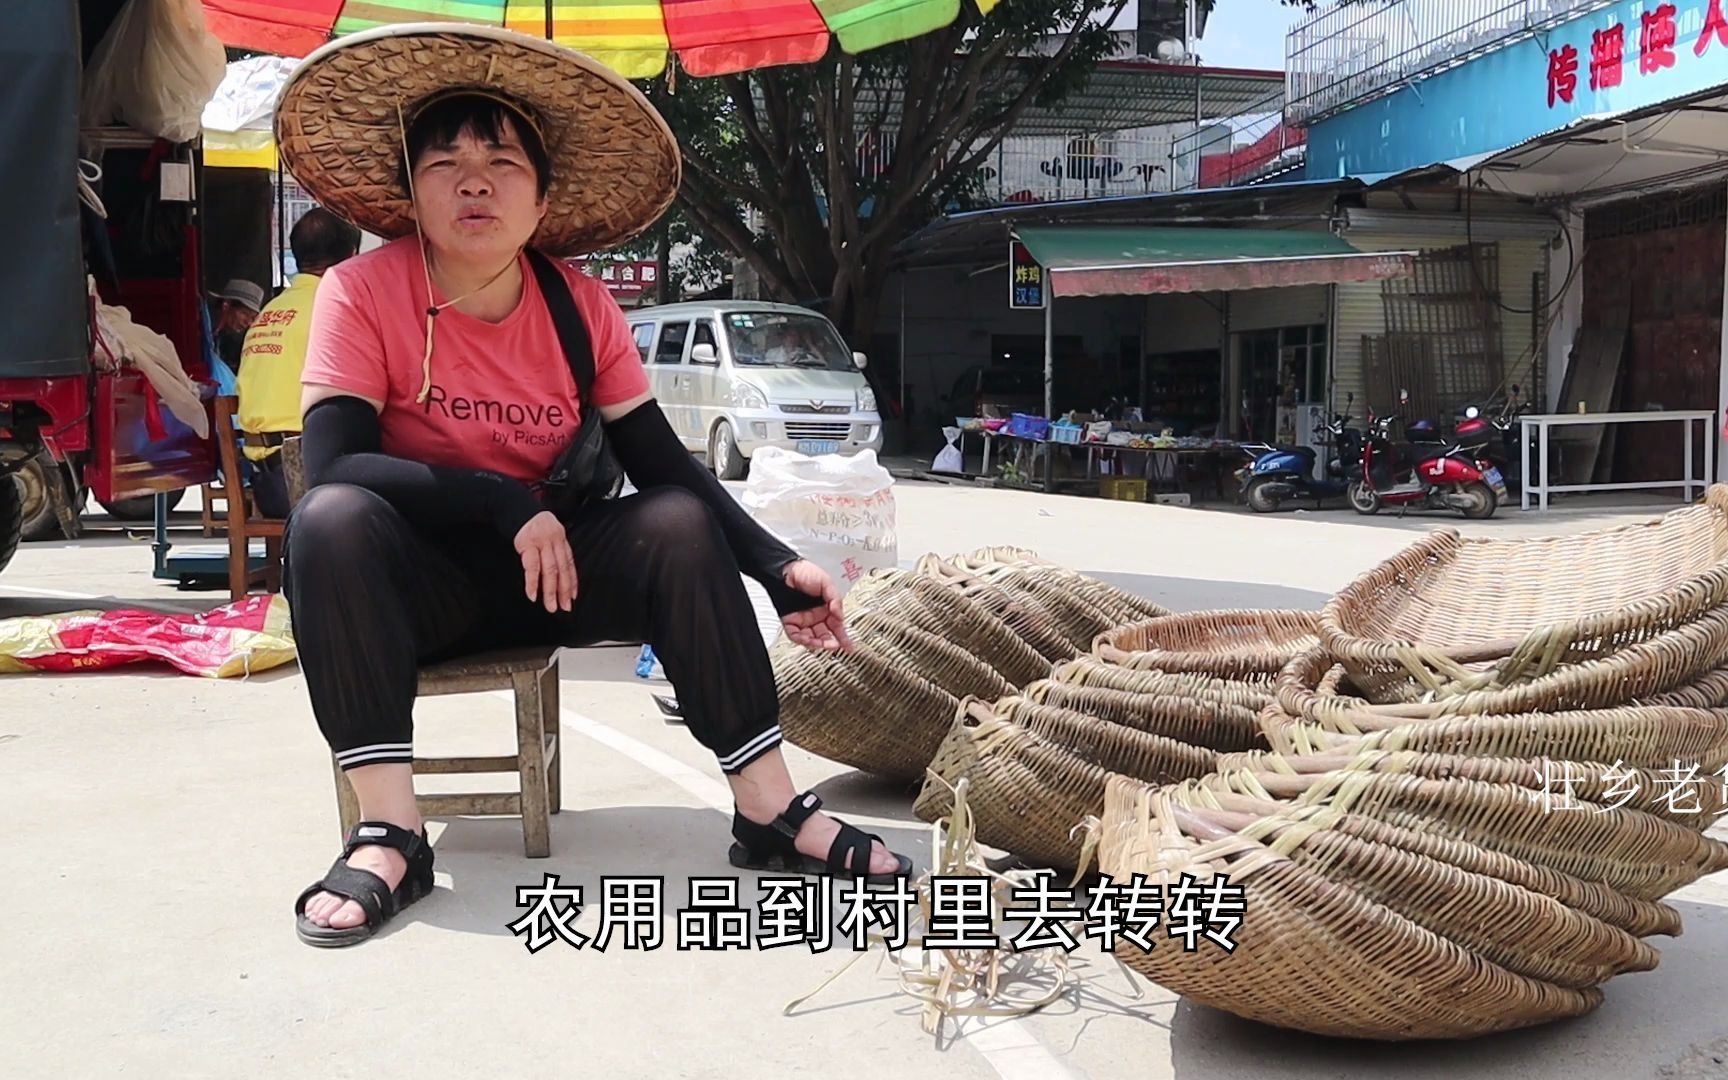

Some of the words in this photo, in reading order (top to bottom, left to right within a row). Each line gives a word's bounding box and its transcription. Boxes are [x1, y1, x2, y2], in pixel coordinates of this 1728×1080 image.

[1015, 265, 1041, 283] 炸鸡
[424, 384, 564, 427] Remove
[492, 429, 510, 448] by
[514, 430, 566, 446] PicsArt
